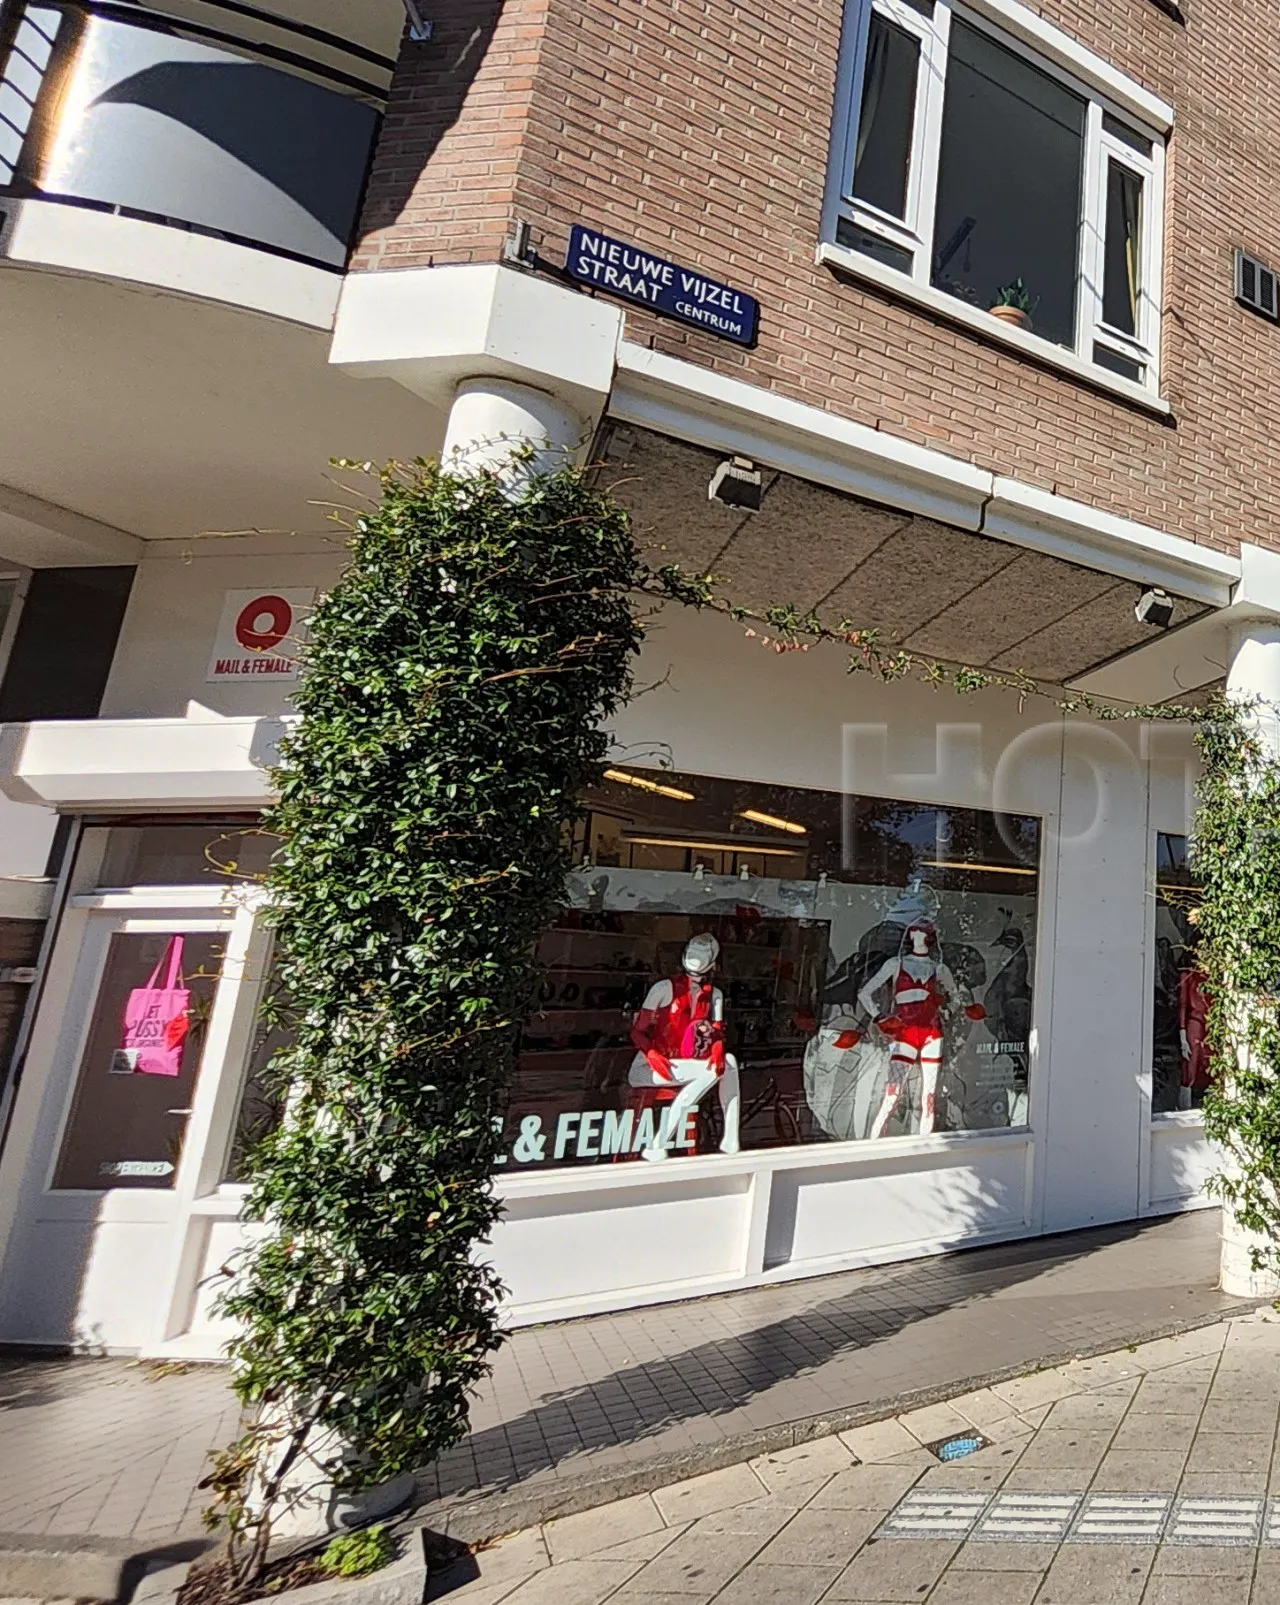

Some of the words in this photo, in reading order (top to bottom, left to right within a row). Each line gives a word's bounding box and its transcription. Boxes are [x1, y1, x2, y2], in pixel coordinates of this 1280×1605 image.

[577, 256, 663, 302] STRAAT
[580, 233, 674, 286] NIEUWE
[680, 273, 743, 315] VIJZEL
[675, 301, 742, 336] CENTRUM
[214, 660, 240, 674] MAIL
[242, 659, 250, 674] &
[251, 659, 293, 674] FEMALE
[513, 1114, 547, 1163] &
[553, 1104, 699, 1160] FEMALE
